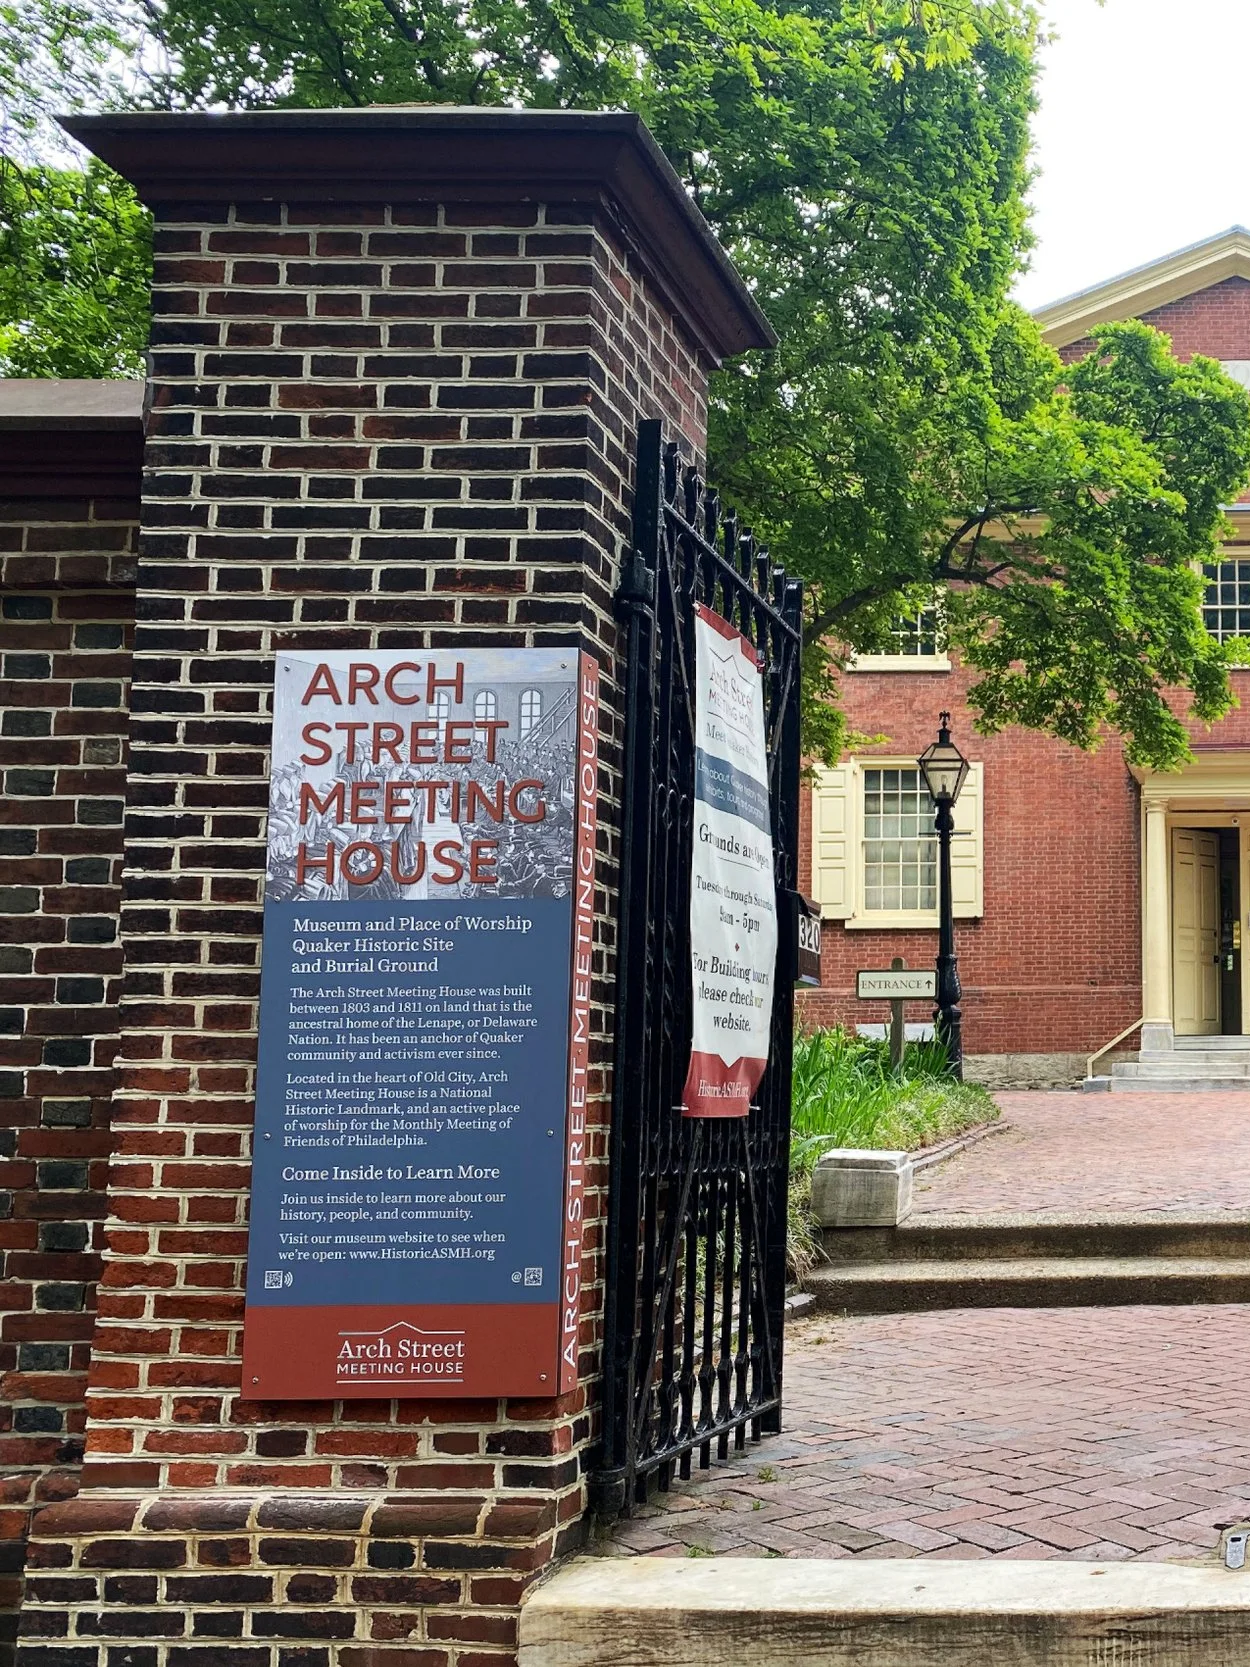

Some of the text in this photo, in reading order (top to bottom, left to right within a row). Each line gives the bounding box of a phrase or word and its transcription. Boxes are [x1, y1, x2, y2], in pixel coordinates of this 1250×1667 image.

[301, 662, 464, 706] ARCH
[300, 720, 508, 766] STREET
[299, 778, 545, 825] MEETING
[296, 839, 499, 885] HOUSE
[293, 915, 532, 934] Museum and Place of Worship
[800, 917, 820, 952] 320
[292, 937, 454, 956] Quaker Historic Site
[291, 957, 438, 973] and Burial Ground
[711, 956, 752, 983] Building
[290, 984, 532, 1000] The Arch Street Meeting House was built
[862, 980, 922, 990] ENTRANCE
[729, 988, 754, 1007] check
[290, 1000, 532, 1014] between 1803 and 1811 on land that is the
[288, 1016, 538, 1031] ancestral home of the Lenape, or Delaware
[563, 674, 598, 1368] ARCH STREET MEETING HOUSE
[713, 1014, 752, 1032] website.
[288, 1031, 524, 1045] Nation. It has been an anchor of Quaker
[287, 1047, 500, 1063] community and activism ever since.
[282, 1165, 500, 1181] Come Inside to Learn More
[280, 1191, 506, 1205] Join us inside to learn more about our
[280, 1207, 474, 1223] history, people, and community.
[279, 1230, 506, 1244] Visit our museum website to see when
[278, 1247, 496, 1263] we're open: www.HistoricASMH.org
[337, 1339, 465, 1359] Arch Street
[337, 1362, 464, 1375] MEETING HOUSE
